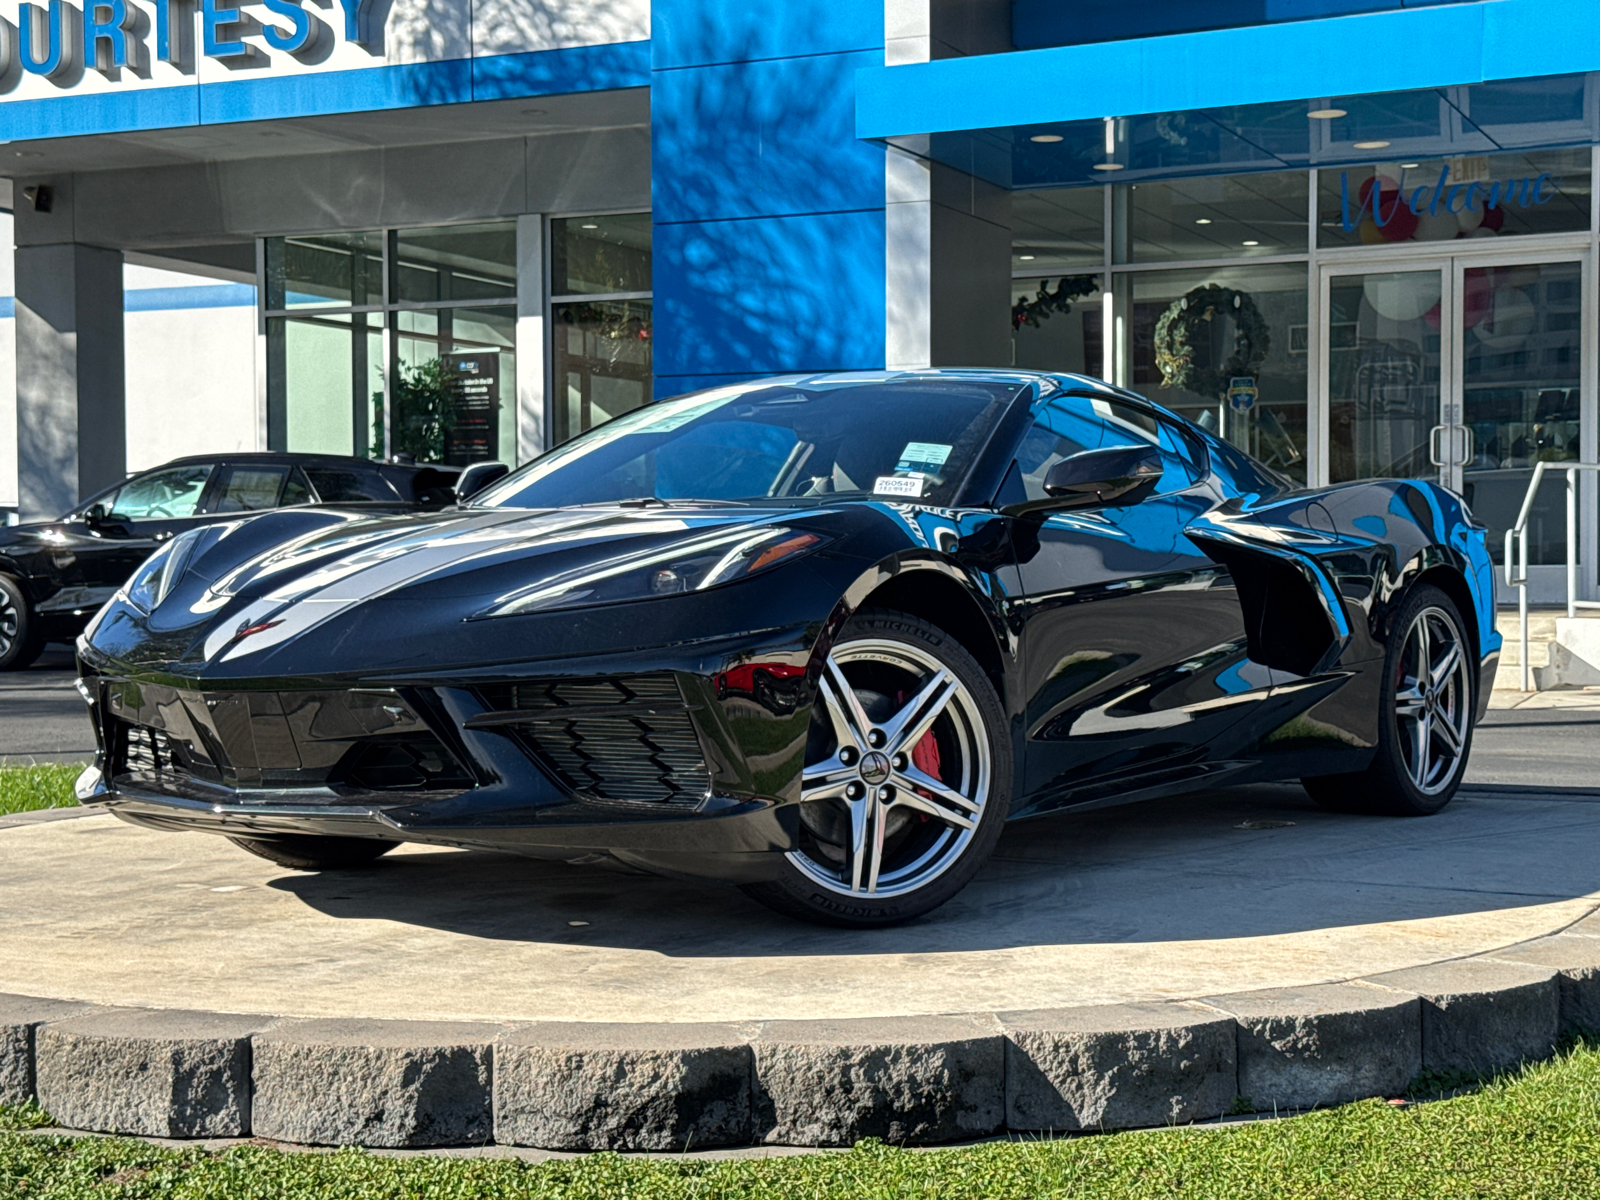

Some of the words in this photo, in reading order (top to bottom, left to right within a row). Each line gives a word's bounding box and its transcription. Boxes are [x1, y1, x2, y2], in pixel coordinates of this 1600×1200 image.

[0, 0, 375, 77] URTESY
[1452, 156, 1483, 182] EXIT
[1341, 164, 1560, 233] Welcome
[878, 480, 916, 488] 260549
[873, 620, 940, 645] MICHELIN
[850, 654, 903, 665] CORVETTE
[812, 892, 882, 917] MICHELIN
